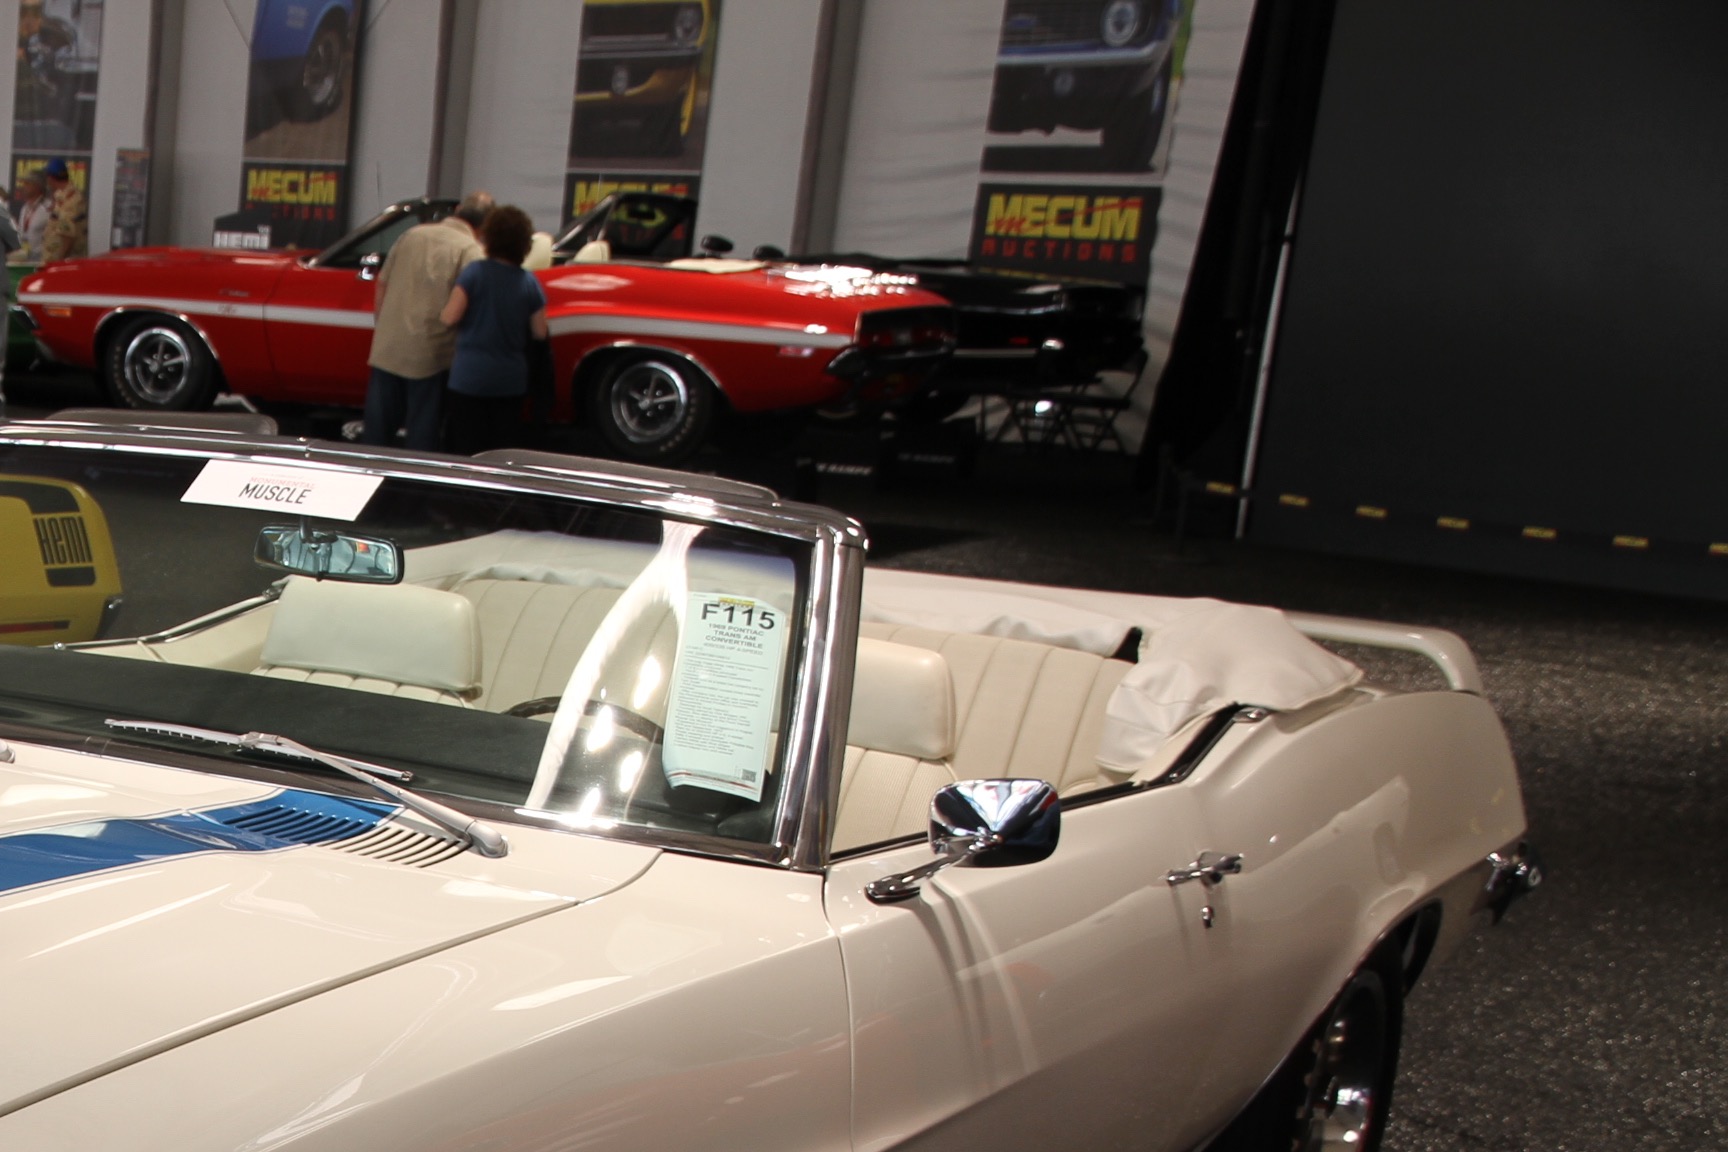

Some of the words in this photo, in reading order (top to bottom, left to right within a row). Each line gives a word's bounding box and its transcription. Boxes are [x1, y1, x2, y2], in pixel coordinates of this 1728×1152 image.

[246, 169, 337, 205] MECUM
[985, 193, 1144, 241] MECUM
[981, 239, 1137, 264] AUCTIONS
[239, 482, 312, 504] MUSCLE
[34, 516, 94, 565] HEMI
[701, 602, 776, 630] F115
[705, 635, 763, 649] CONVERTIBLE
[714, 630, 742, 639] TRANS
[728, 626, 764, 637] PONTIAC
